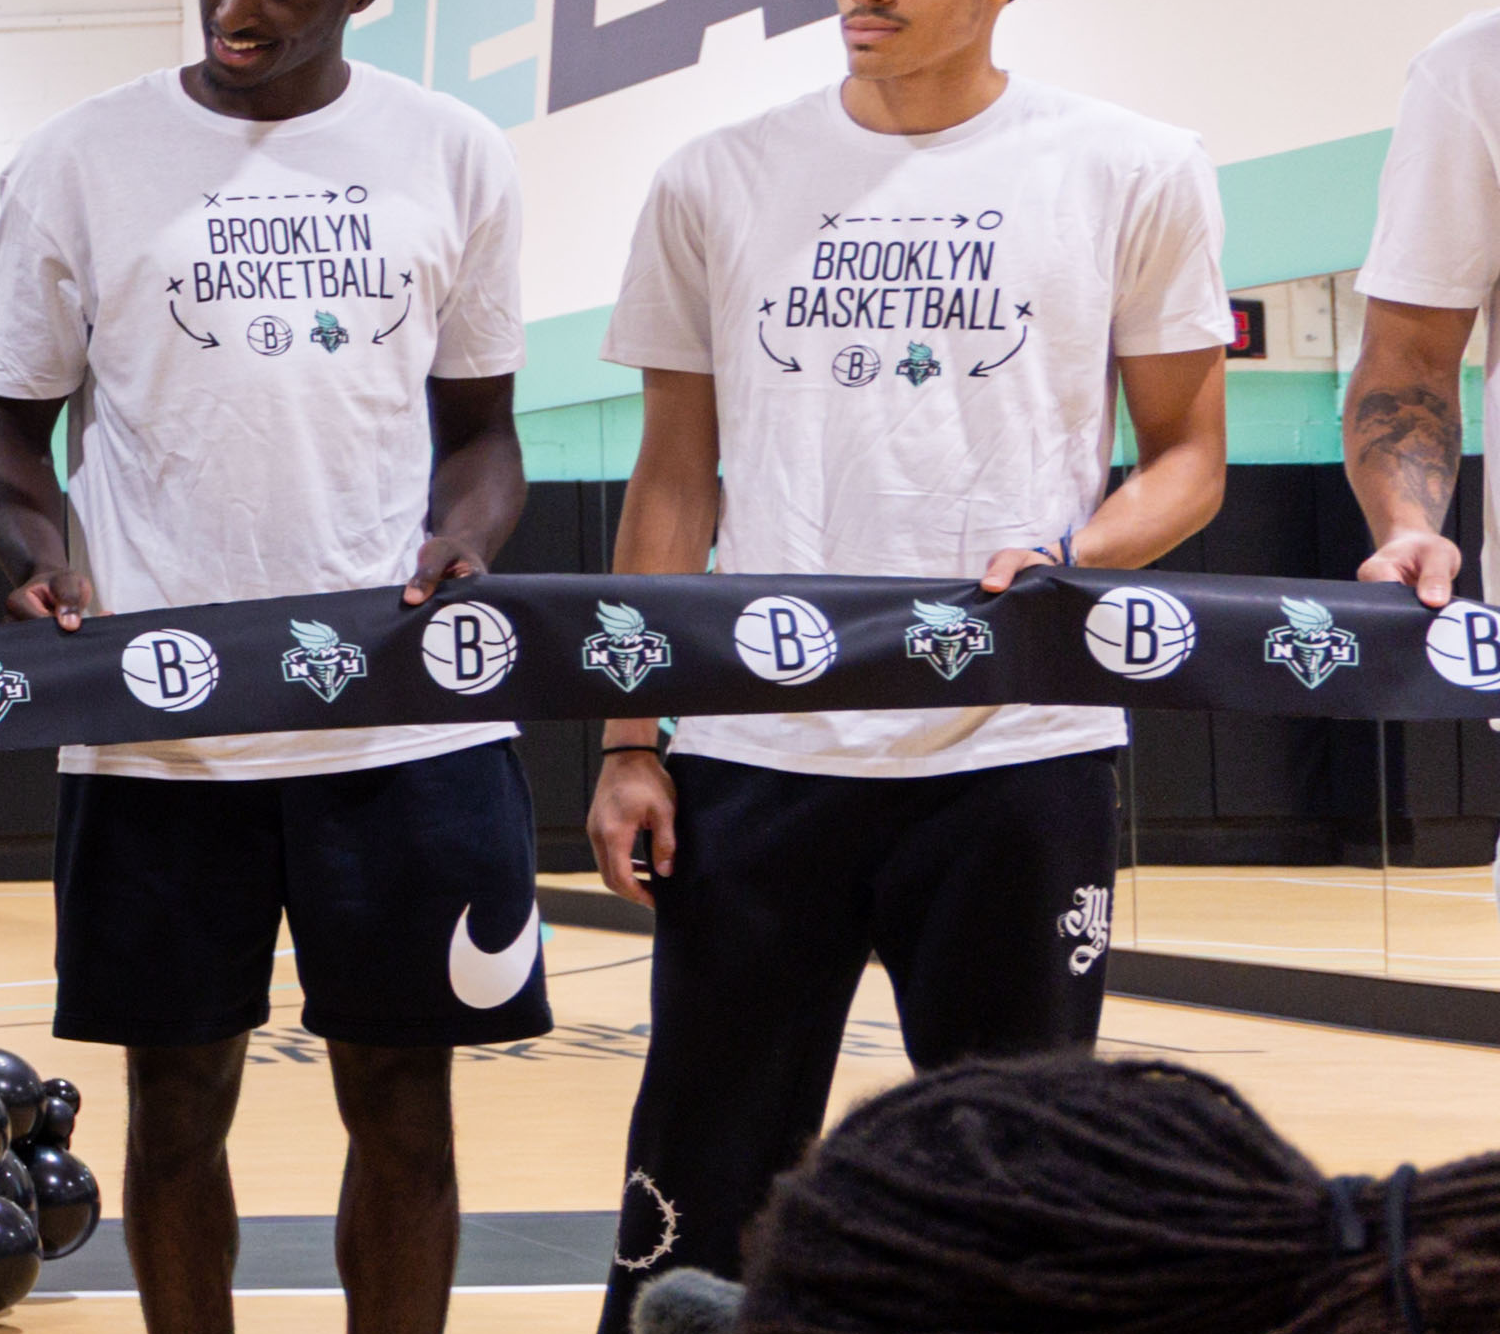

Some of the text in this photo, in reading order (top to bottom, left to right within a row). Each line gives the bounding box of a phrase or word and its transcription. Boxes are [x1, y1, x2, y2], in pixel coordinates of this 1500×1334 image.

[207, 213, 372, 255] BROOKLYN
[812, 240, 996, 281] BROOKLYN
[193, 257, 395, 303] BASKETBALL
[785, 286, 1006, 330] BASKETBALL
[453, 614, 484, 681] B
[769, 608, 806, 672] B
[1124, 598, 1158, 666] B
[1465, 612, 1500, 677] B
[152, 639, 189, 699] B
